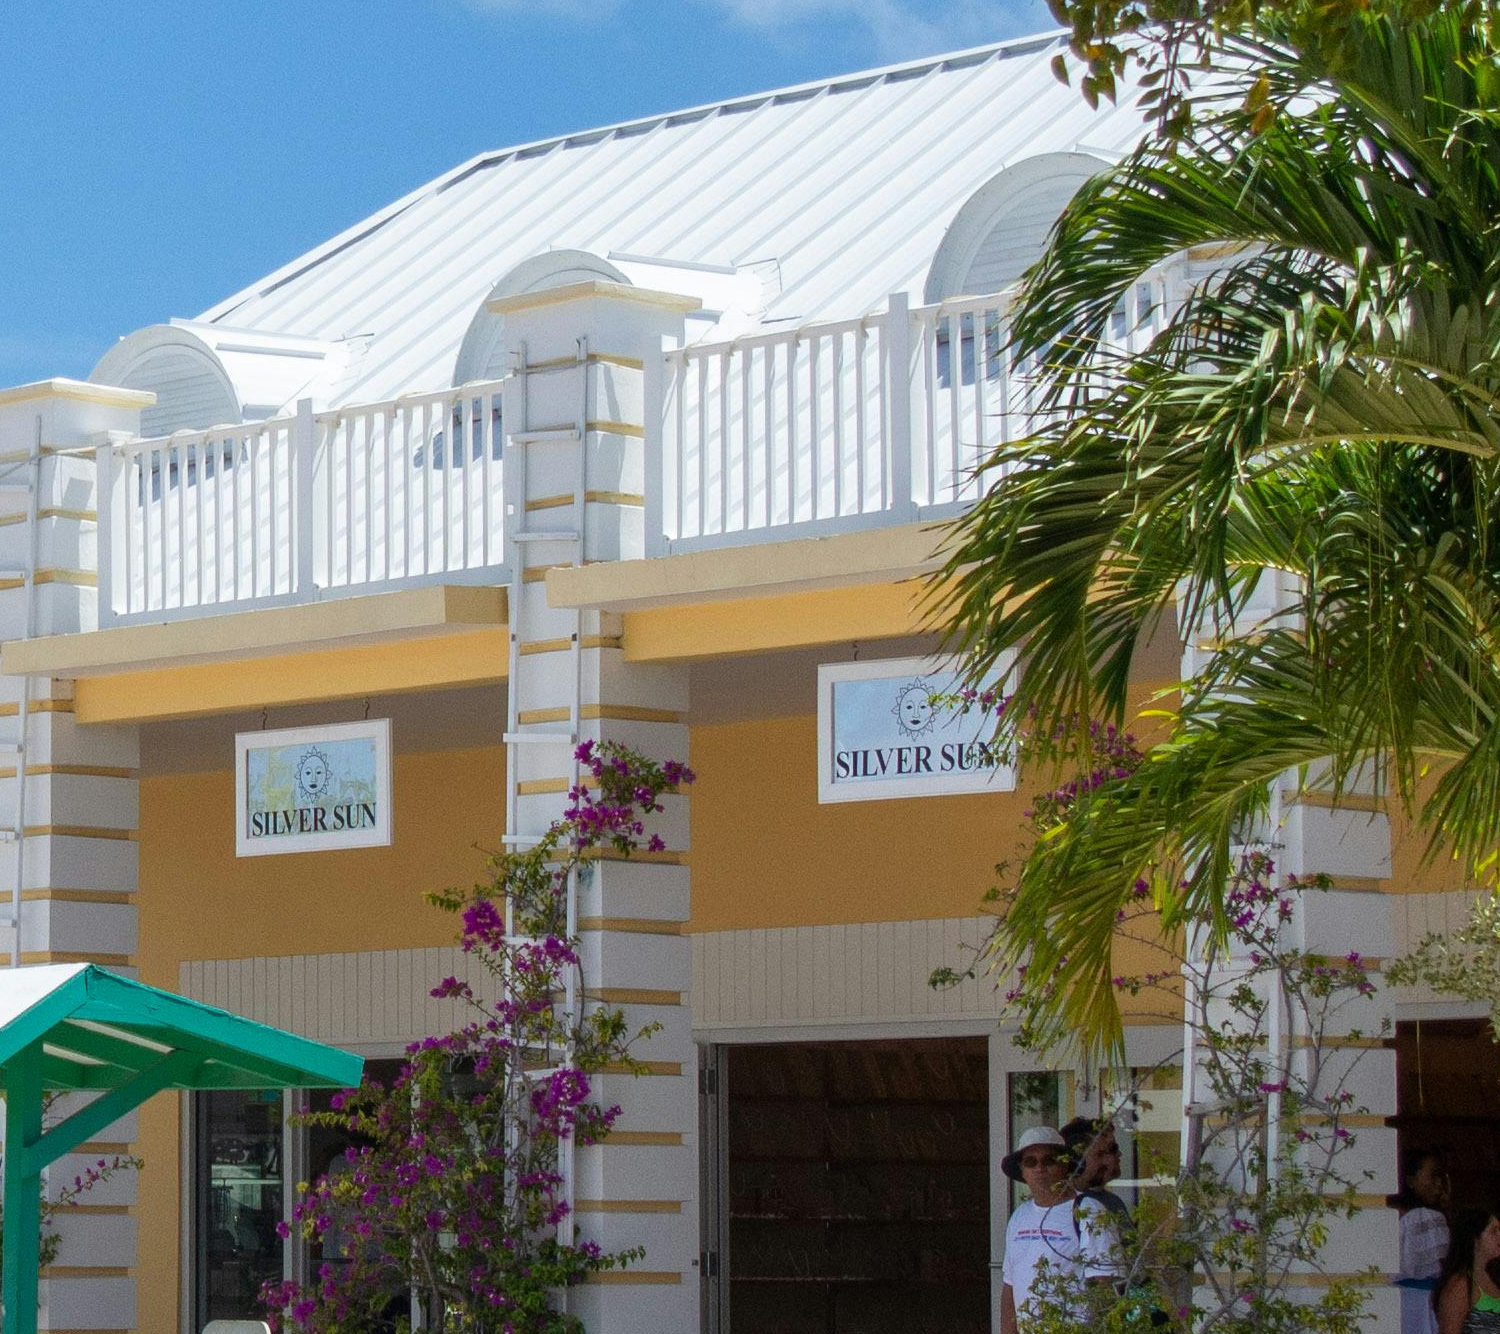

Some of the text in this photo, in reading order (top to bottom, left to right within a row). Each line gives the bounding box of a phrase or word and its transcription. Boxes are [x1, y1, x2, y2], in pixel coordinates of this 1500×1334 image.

[836, 745, 934, 779] SILVER
[252, 802, 377, 836] SILVER SUN
